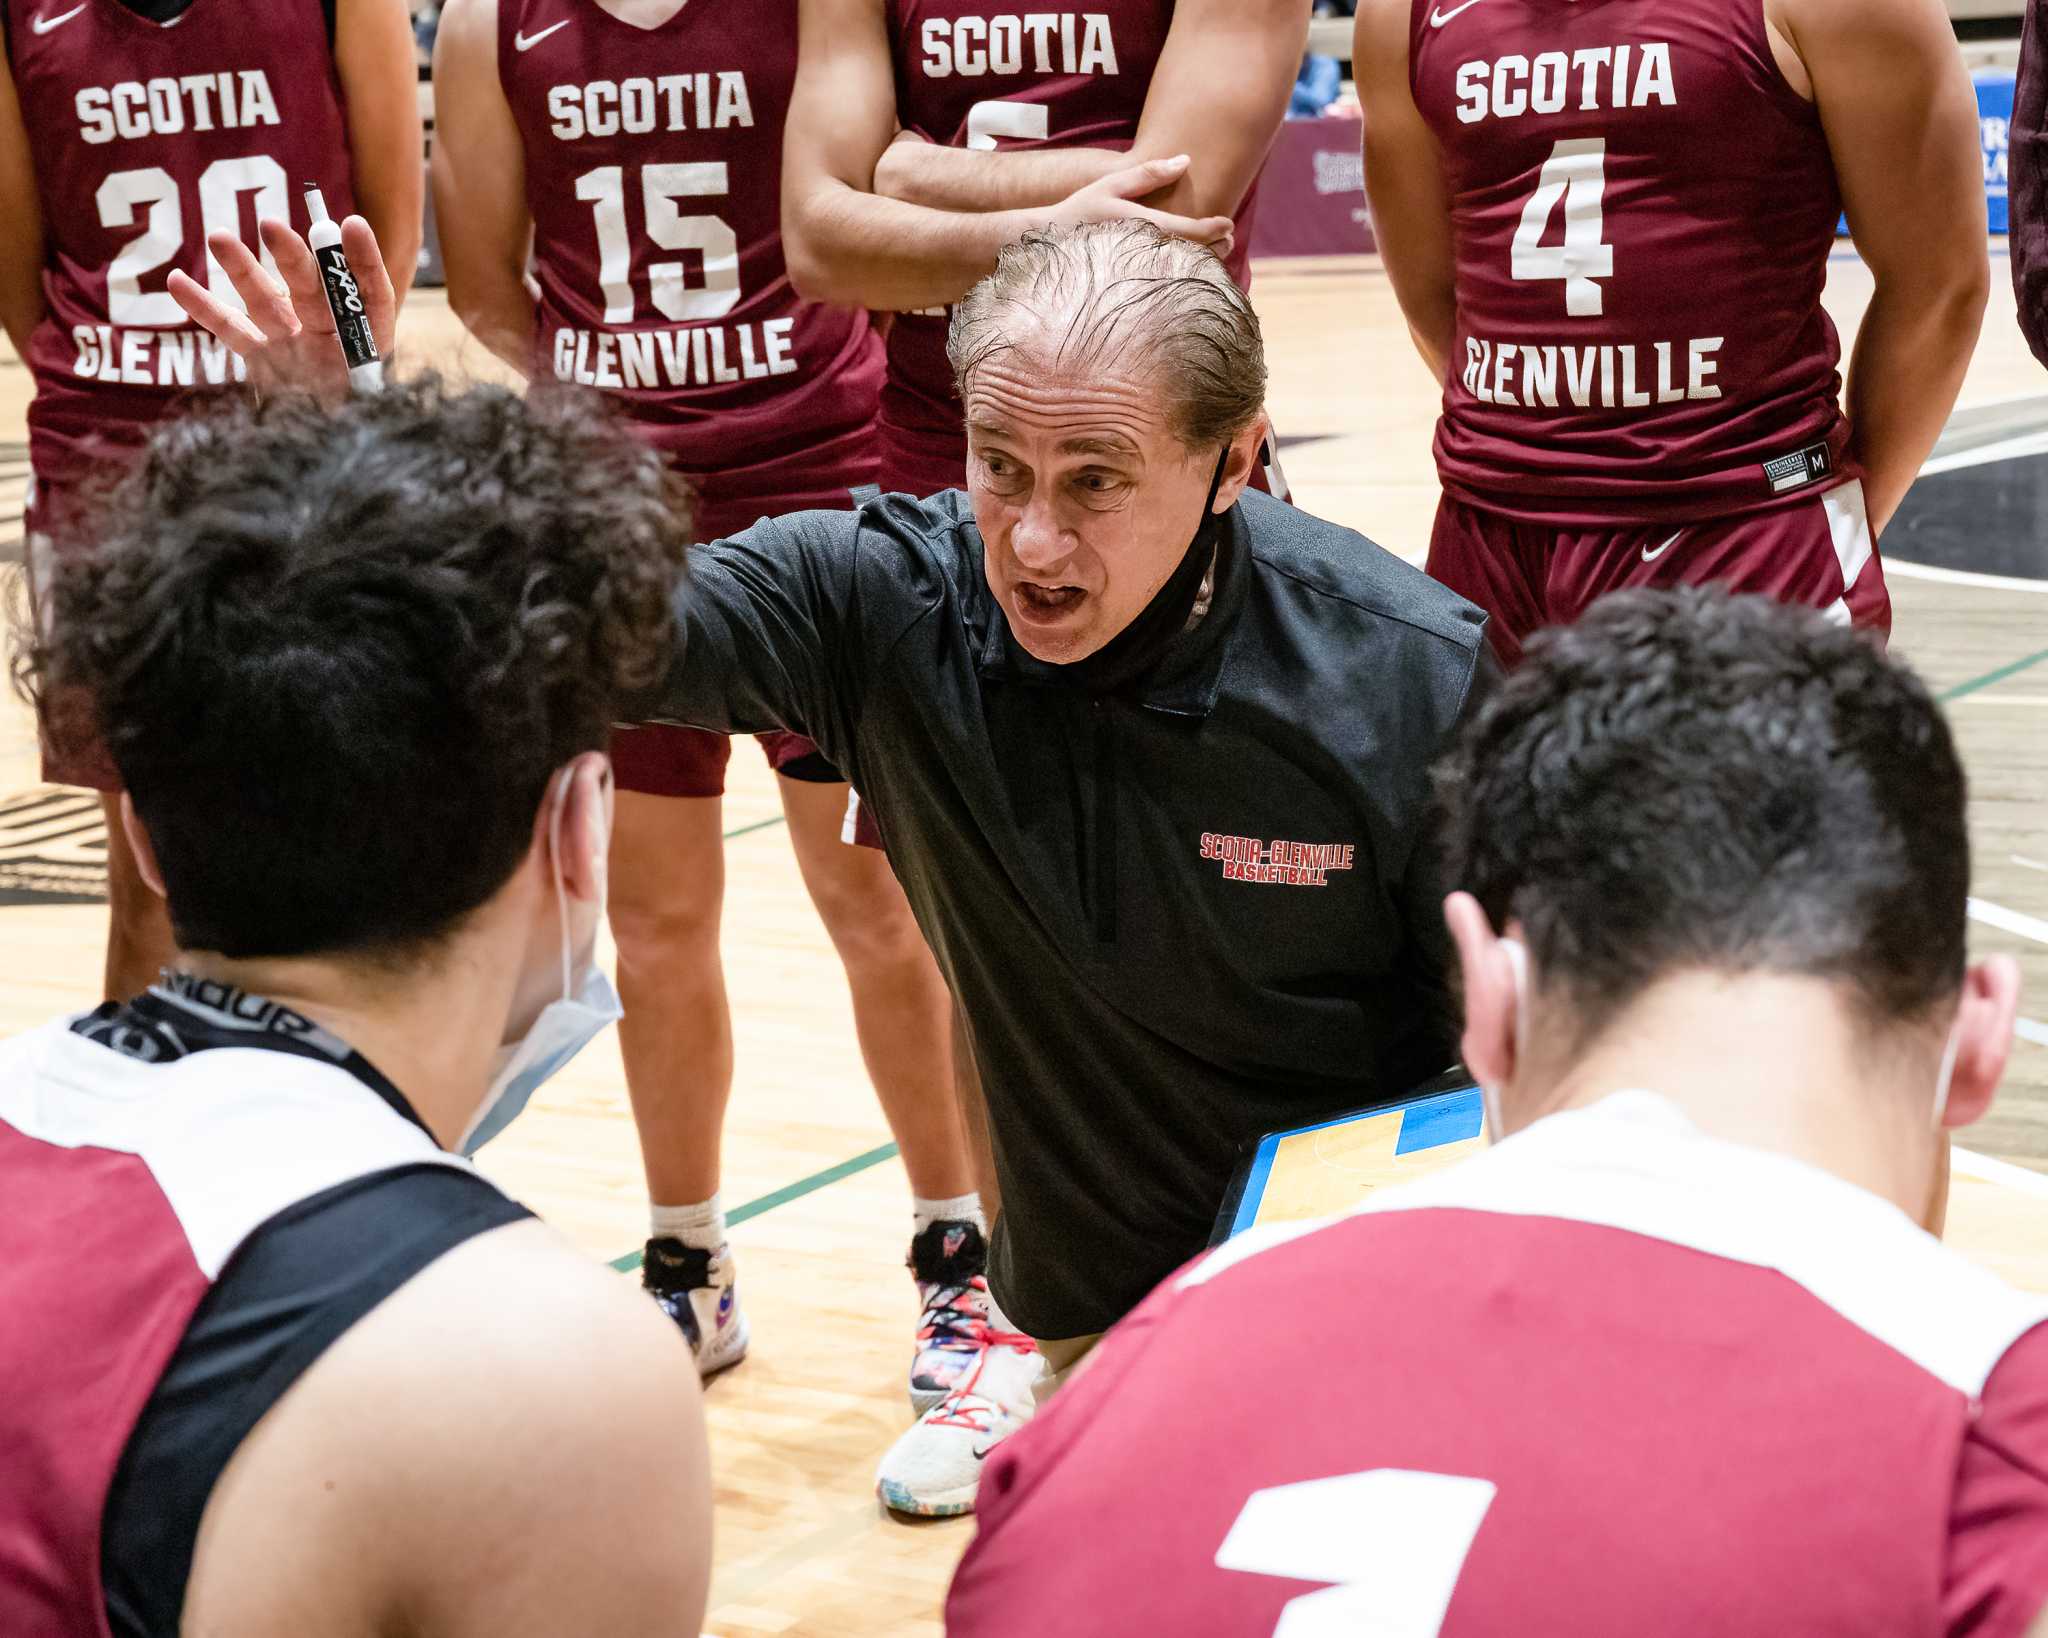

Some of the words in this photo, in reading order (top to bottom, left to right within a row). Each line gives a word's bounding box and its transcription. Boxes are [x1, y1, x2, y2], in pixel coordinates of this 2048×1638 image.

[921, 13, 1120, 79] SCOTIA
[74, 69, 282, 145] SCOTIA
[547, 70, 755, 141] SCOTIA
[1455, 42, 1677, 124] SCOTIA
[95, 154, 292, 326] 20
[574, 161, 742, 324] 15
[1510, 136, 1614, 317] 4
[328, 250, 363, 312] EXPO
[553, 316, 799, 389] GLENVILLE
[1462, 337, 1724, 408] GLENVILLE
[1811, 453, 1825, 472] M
[1200, 832, 1355, 869] SCOTIA-GLENVILLE
[1223, 859, 1328, 886] BASKETBALL
